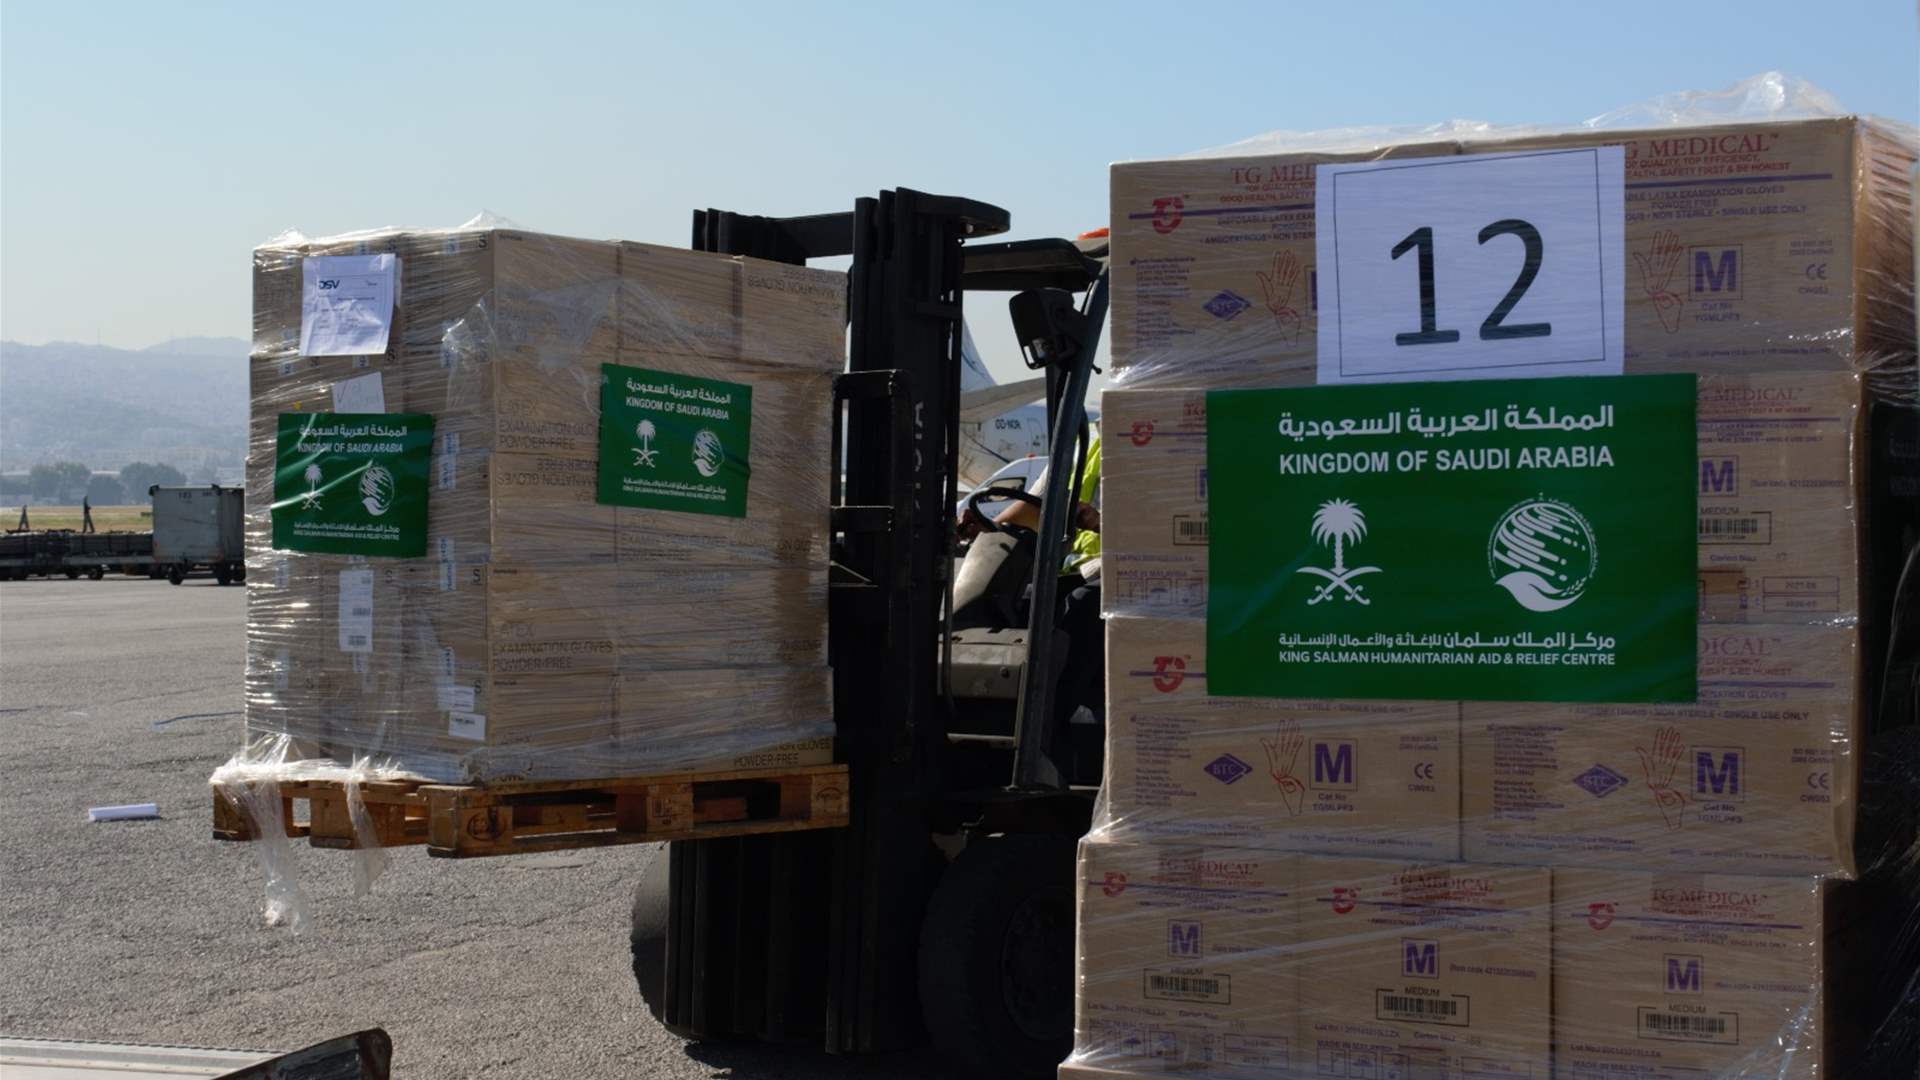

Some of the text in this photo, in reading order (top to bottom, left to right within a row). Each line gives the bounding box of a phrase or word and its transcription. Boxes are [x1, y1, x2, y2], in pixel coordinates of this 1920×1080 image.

[1391, 218, 1551, 346] 12
[1694, 250, 1737, 293] M
[626, 397, 729, 420] KINGDOM OF SAUDI ARABIA
[1278, 404, 1614, 442] المملكة العربية السعودية
[334, 443, 346, 453] OF
[1280, 445, 1614, 475] KINGDOM OF SAUDI ARABIA
[1701, 460, 1734, 493] M
[1443, 631, 1510, 648] سلمان
[1512, 631, 1565, 648] الملك
[1569, 632, 1616, 650] مركز
[1279, 651, 1615, 665] KING SALMAN HUMANITARIAN AID & RELIEF CENTRE
[1761, 711, 1780, 720] USE
[1783, 711, 1809, 721] ONLY
[1315, 743, 1353, 783] M
[1696, 752, 1739, 794] M
[1680, 889, 1759, 905] MEDICAL
[1171, 923, 1199, 954] M
[1406, 943, 1435, 974] M
[1667, 958, 1699, 991] M
[1405, 987, 1440, 997] MEDIUM
[1669, 1004, 1706, 1014] MEDIUM
